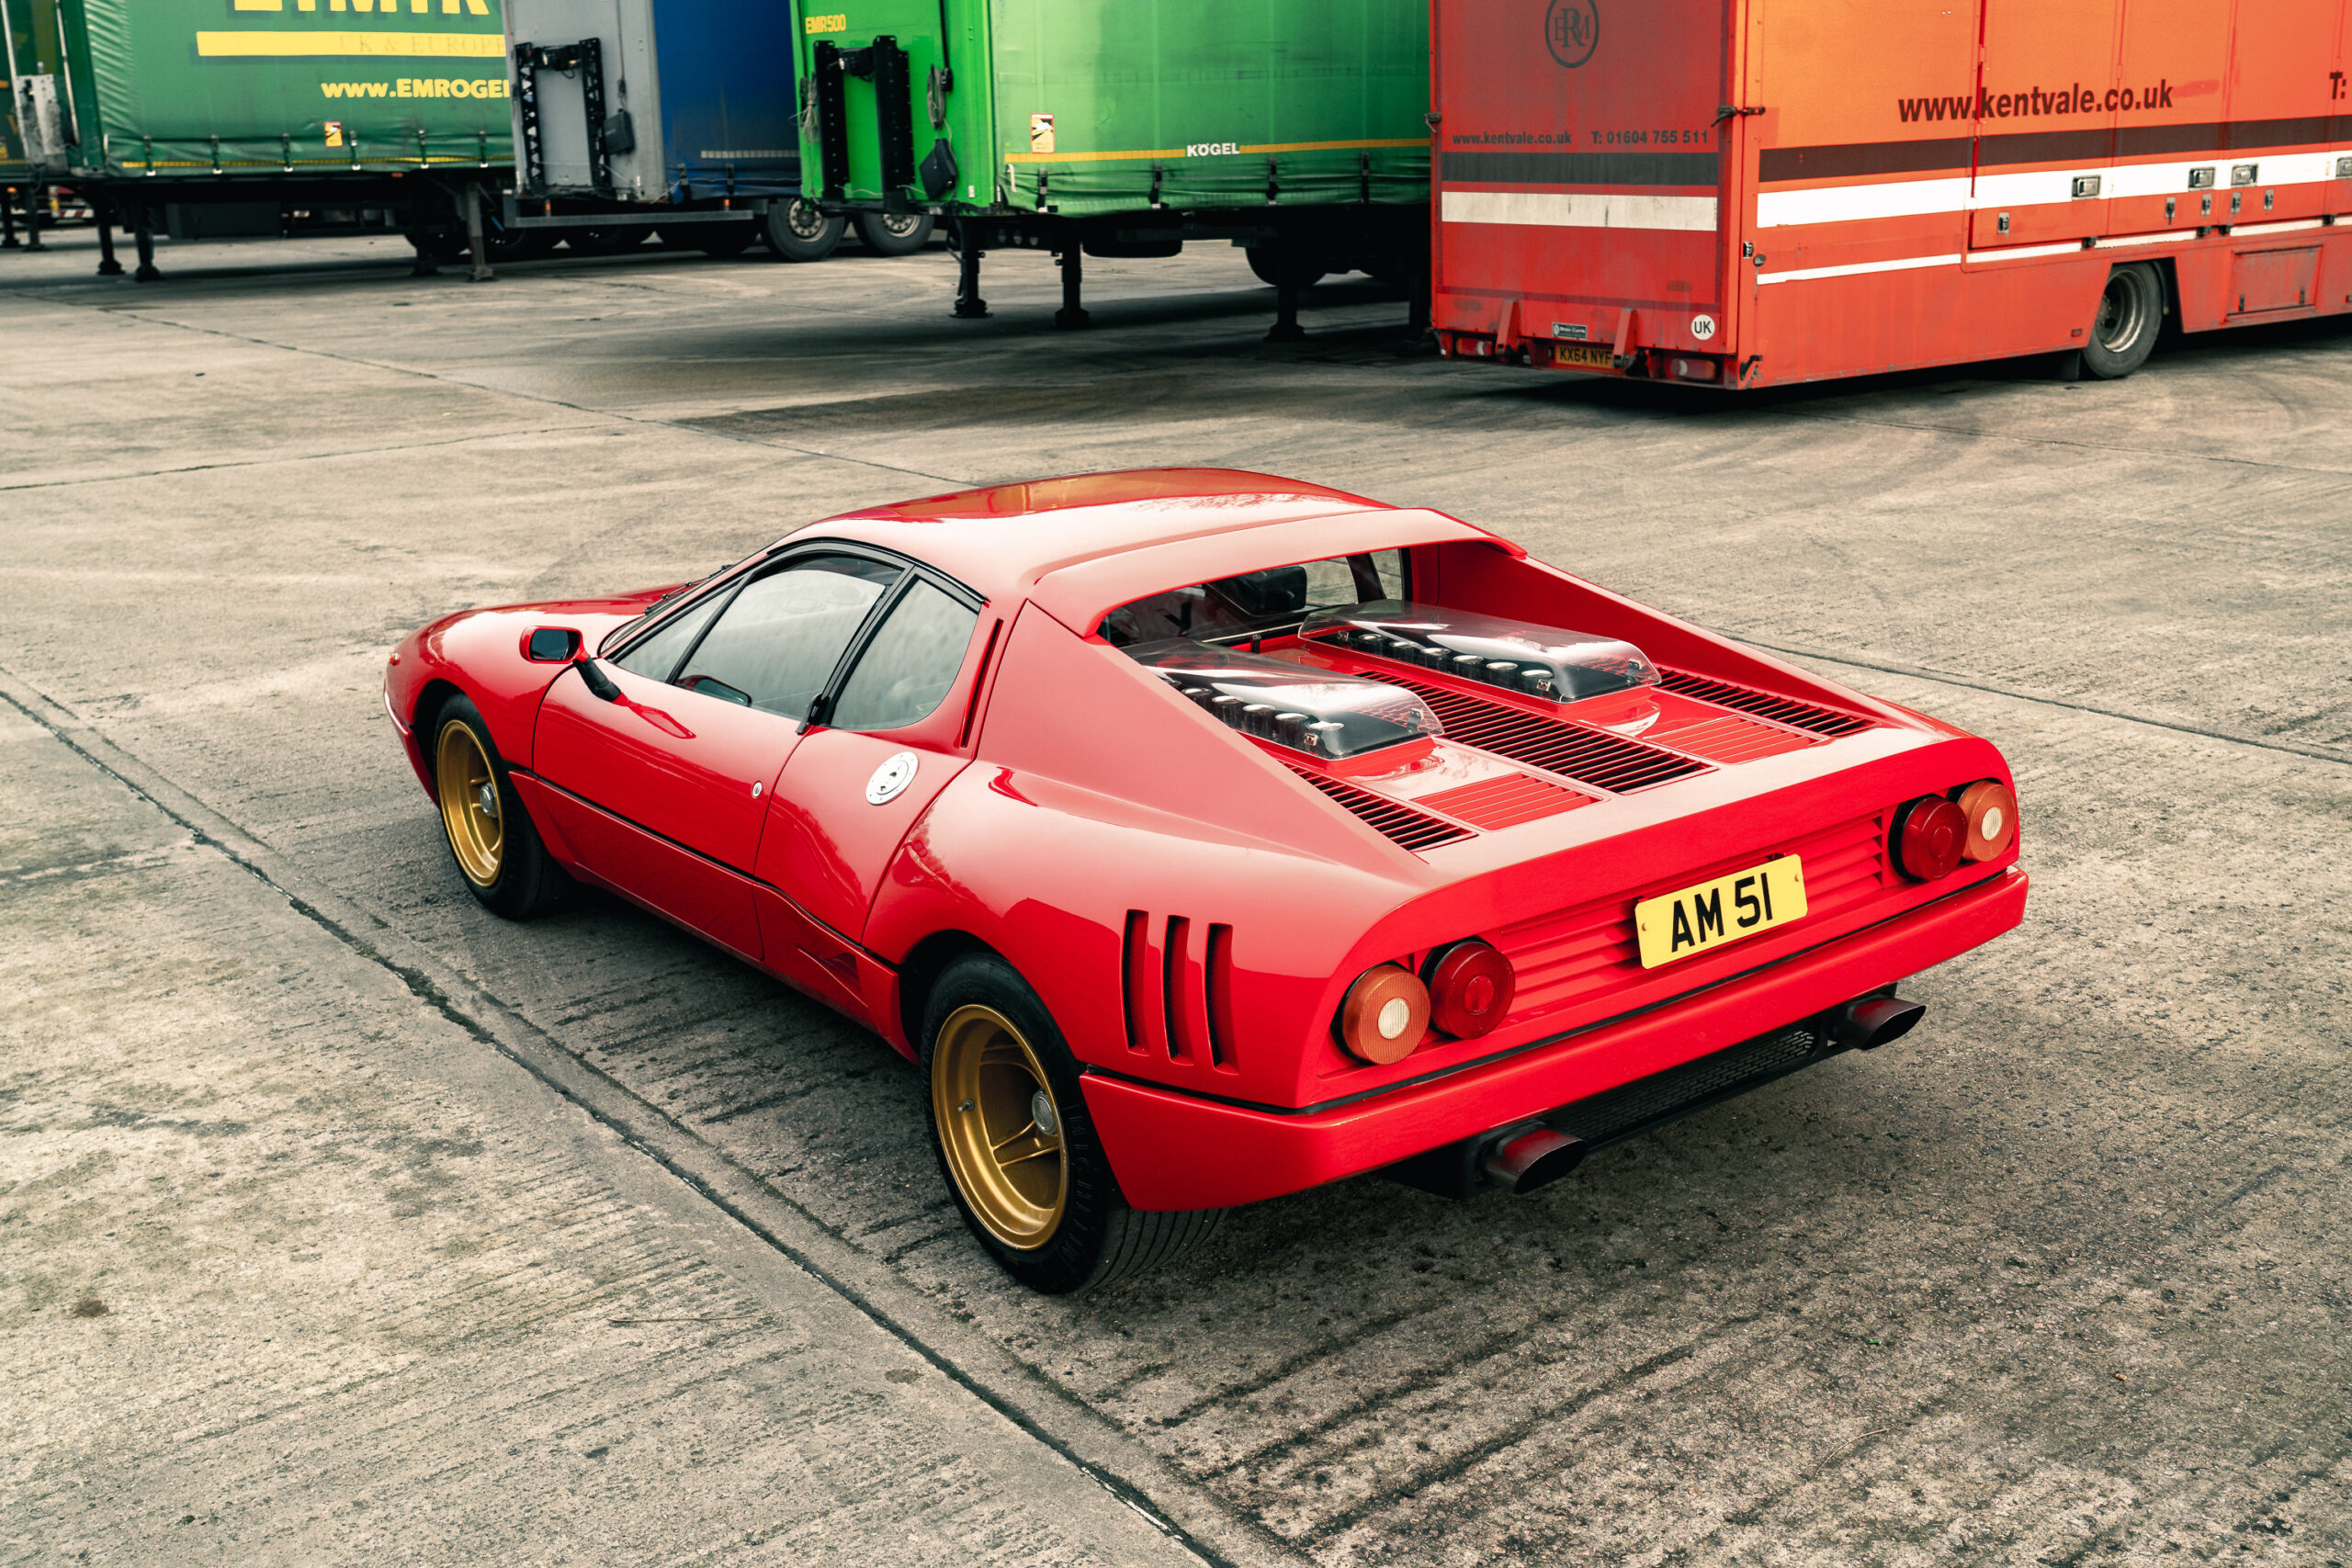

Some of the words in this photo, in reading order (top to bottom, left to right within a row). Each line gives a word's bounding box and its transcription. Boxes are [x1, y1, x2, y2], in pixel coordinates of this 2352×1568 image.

[805, 13, 846, 34] EMR500
[2329, 71, 2346, 100] T:
[1898, 79, 2174, 122] www.kentvale.co.uk
[1452, 130, 1572, 144] www.kentvale.co.uk
[1591, 130, 1602, 144] T:
[1607, 130, 1647, 144] 01604
[1653, 130, 1678, 143] 755
[1682, 130, 1708, 143] 511
[1187, 142, 1240, 157] KÖGEL
[1694, 321, 1712, 334] UK
[1559, 345, 1588, 363] KX64
[1671, 887, 1724, 953] AM
[1735, 872, 1773, 929] 51
